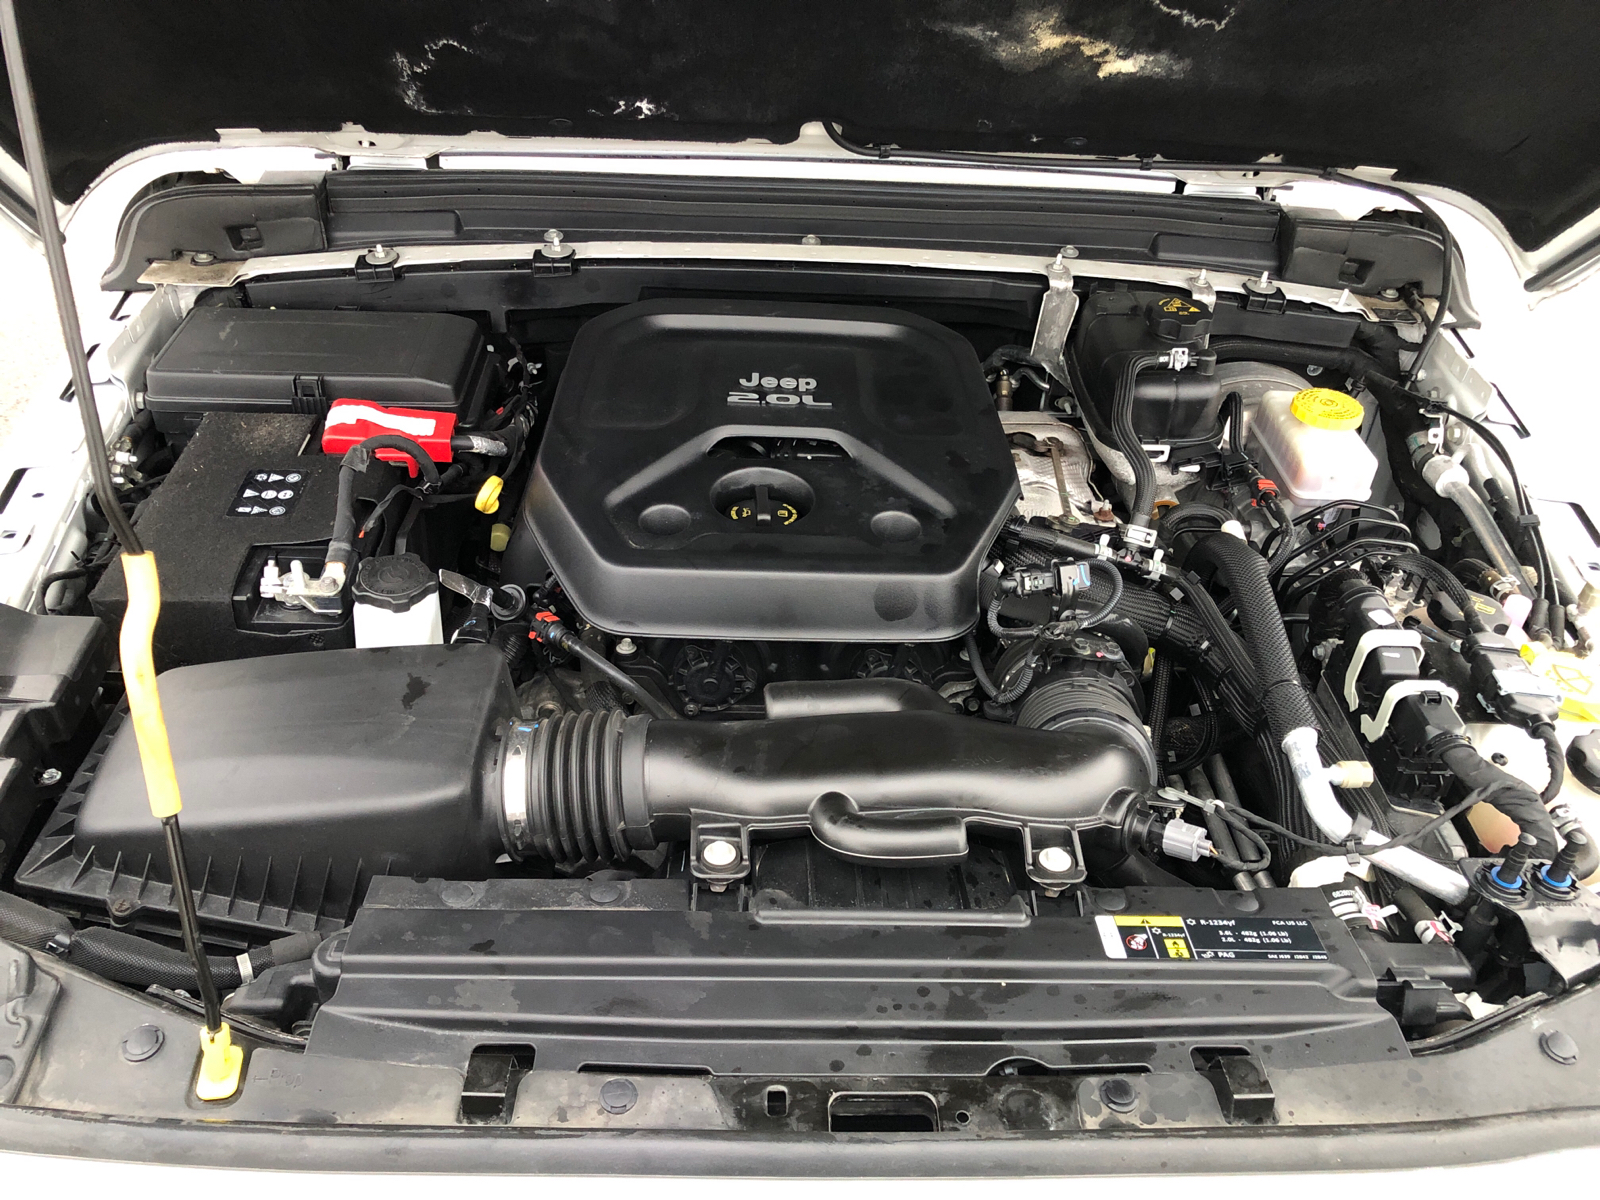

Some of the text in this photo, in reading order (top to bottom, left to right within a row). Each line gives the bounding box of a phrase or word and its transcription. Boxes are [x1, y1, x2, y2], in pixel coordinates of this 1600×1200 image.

[739, 372, 817, 392] Jeep
[727, 391, 832, 406] 2.0L
[1200, 919, 1236, 927] R-1234yf
